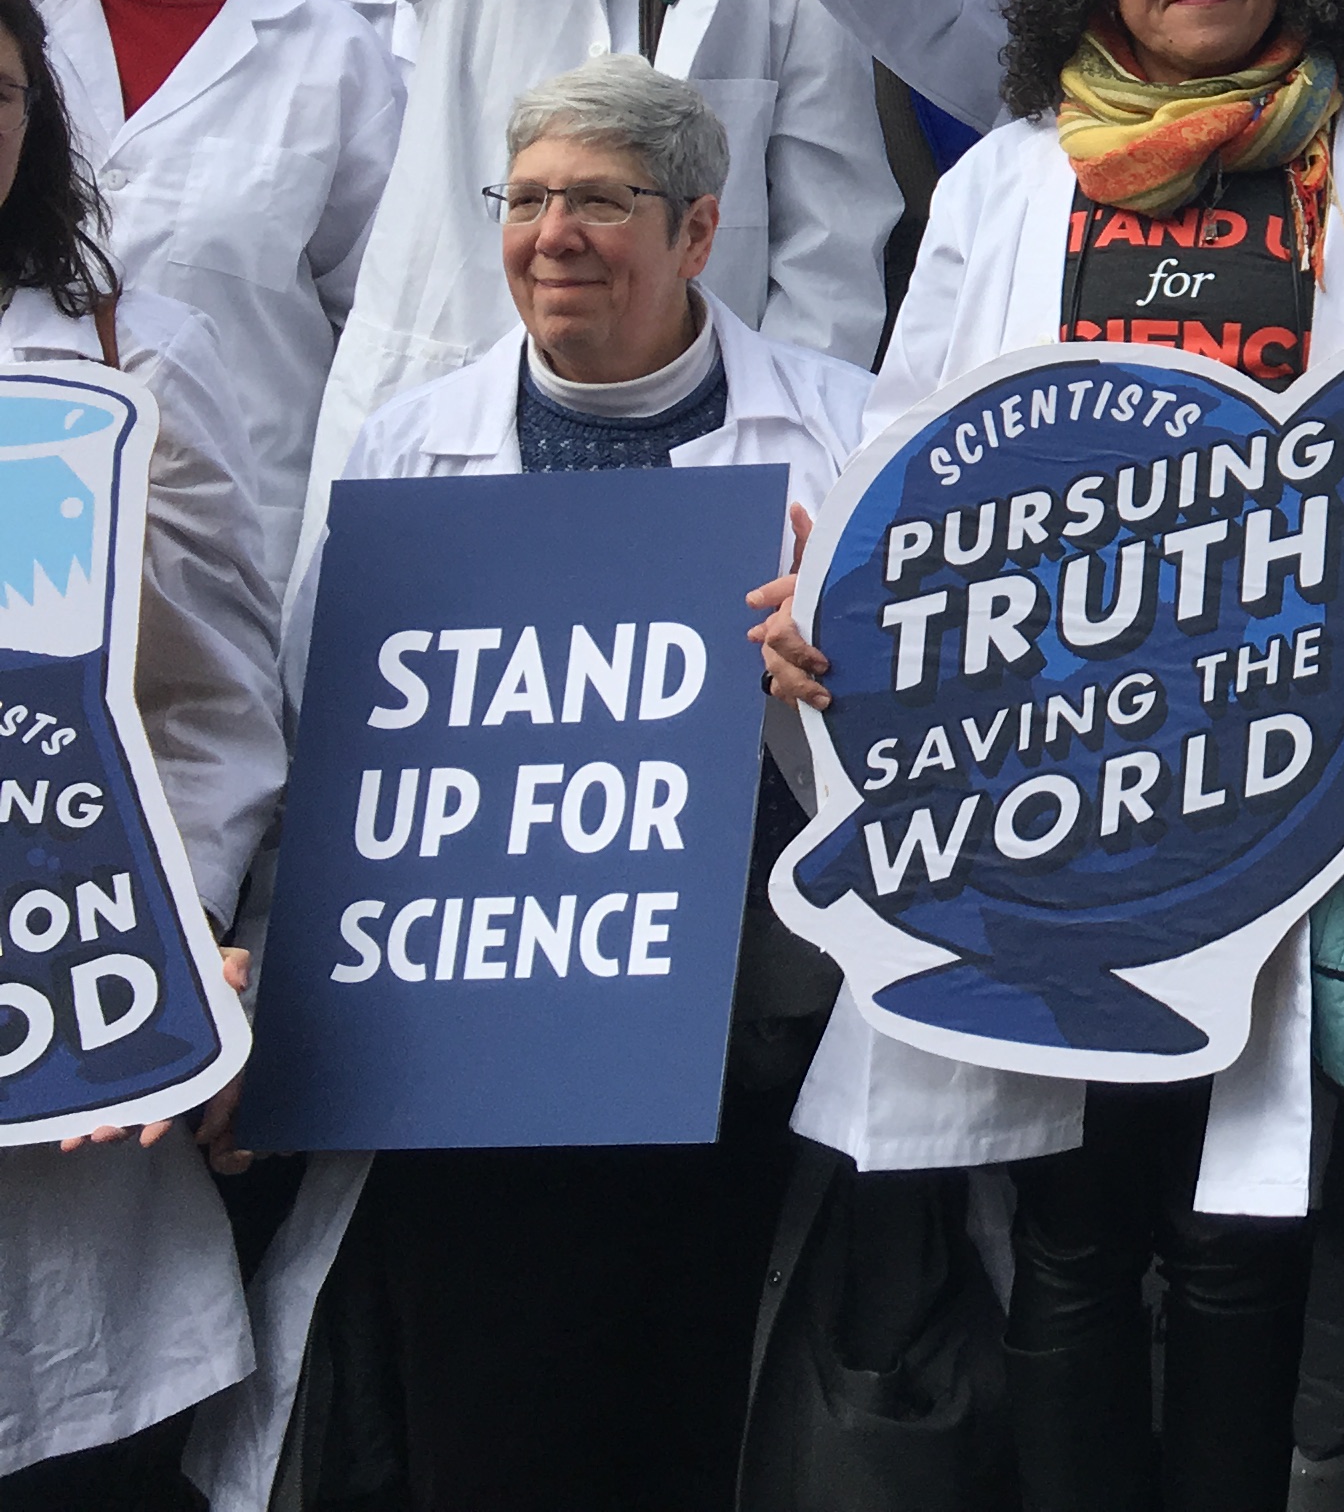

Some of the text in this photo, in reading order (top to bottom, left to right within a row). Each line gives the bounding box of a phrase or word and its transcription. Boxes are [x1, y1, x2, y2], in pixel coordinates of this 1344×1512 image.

[1136, 258, 1215, 306] for
[929, 380, 1201, 486] SCIENTISTS
[886, 421, 1335, 582] PURSUING
[881, 495, 1329, 691] TRUTH
[366, 621, 707, 731] STAND
[863, 627, 1321, 791] SAVING THE
[355, 761, 689, 860] UP FOR
[863, 712, 1313, 897] WORLD
[330, 891, 679, 983] SCIENCE
